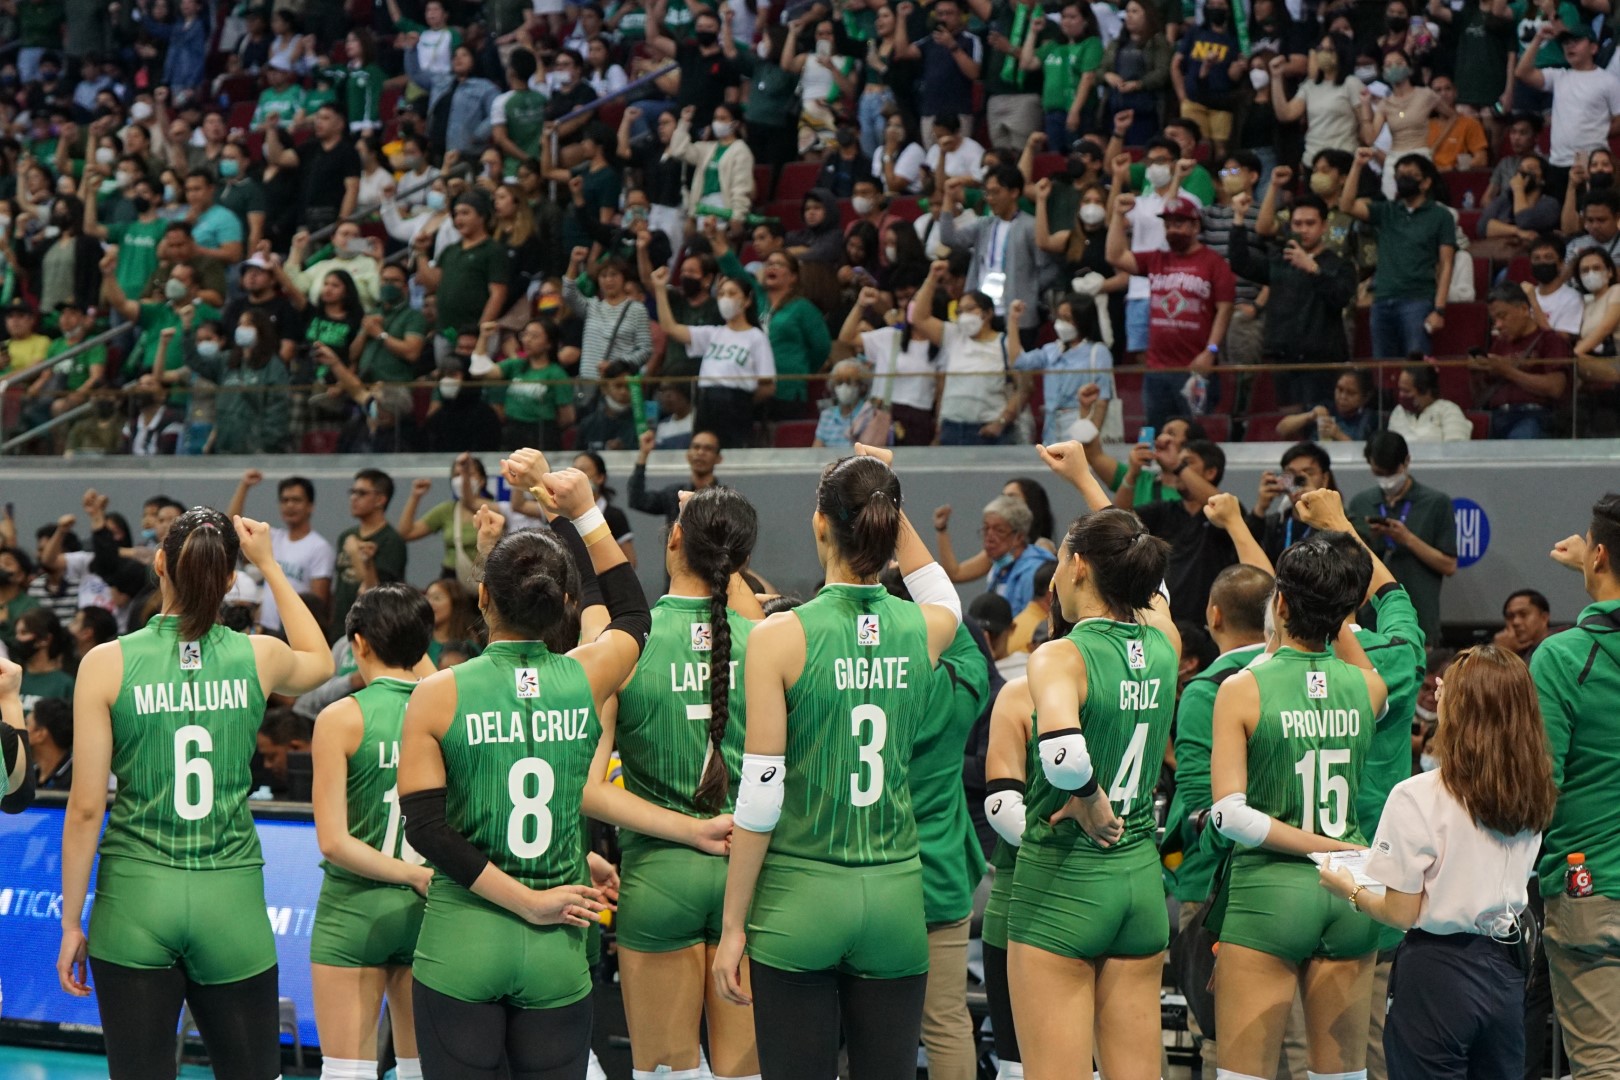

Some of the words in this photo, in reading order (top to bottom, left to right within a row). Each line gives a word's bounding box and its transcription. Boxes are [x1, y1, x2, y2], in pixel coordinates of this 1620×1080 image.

[671, 661, 739, 692] LAPT
[834, 656, 909, 690] GIGATE
[134, 679, 248, 715] MALALUAN
[1119, 678, 1161, 711] CRUZ
[466, 711, 526, 745] DELA
[531, 707, 590, 742] CRUZ
[1280, 708, 1360, 738] PROVIDO
[174, 725, 213, 820] 6
[850, 704, 887, 807] 3
[1108, 723, 1149, 817] 4
[507, 757, 555, 859] 8
[1294, 748, 1351, 839] 15
[1576, 873, 1589, 886] G
